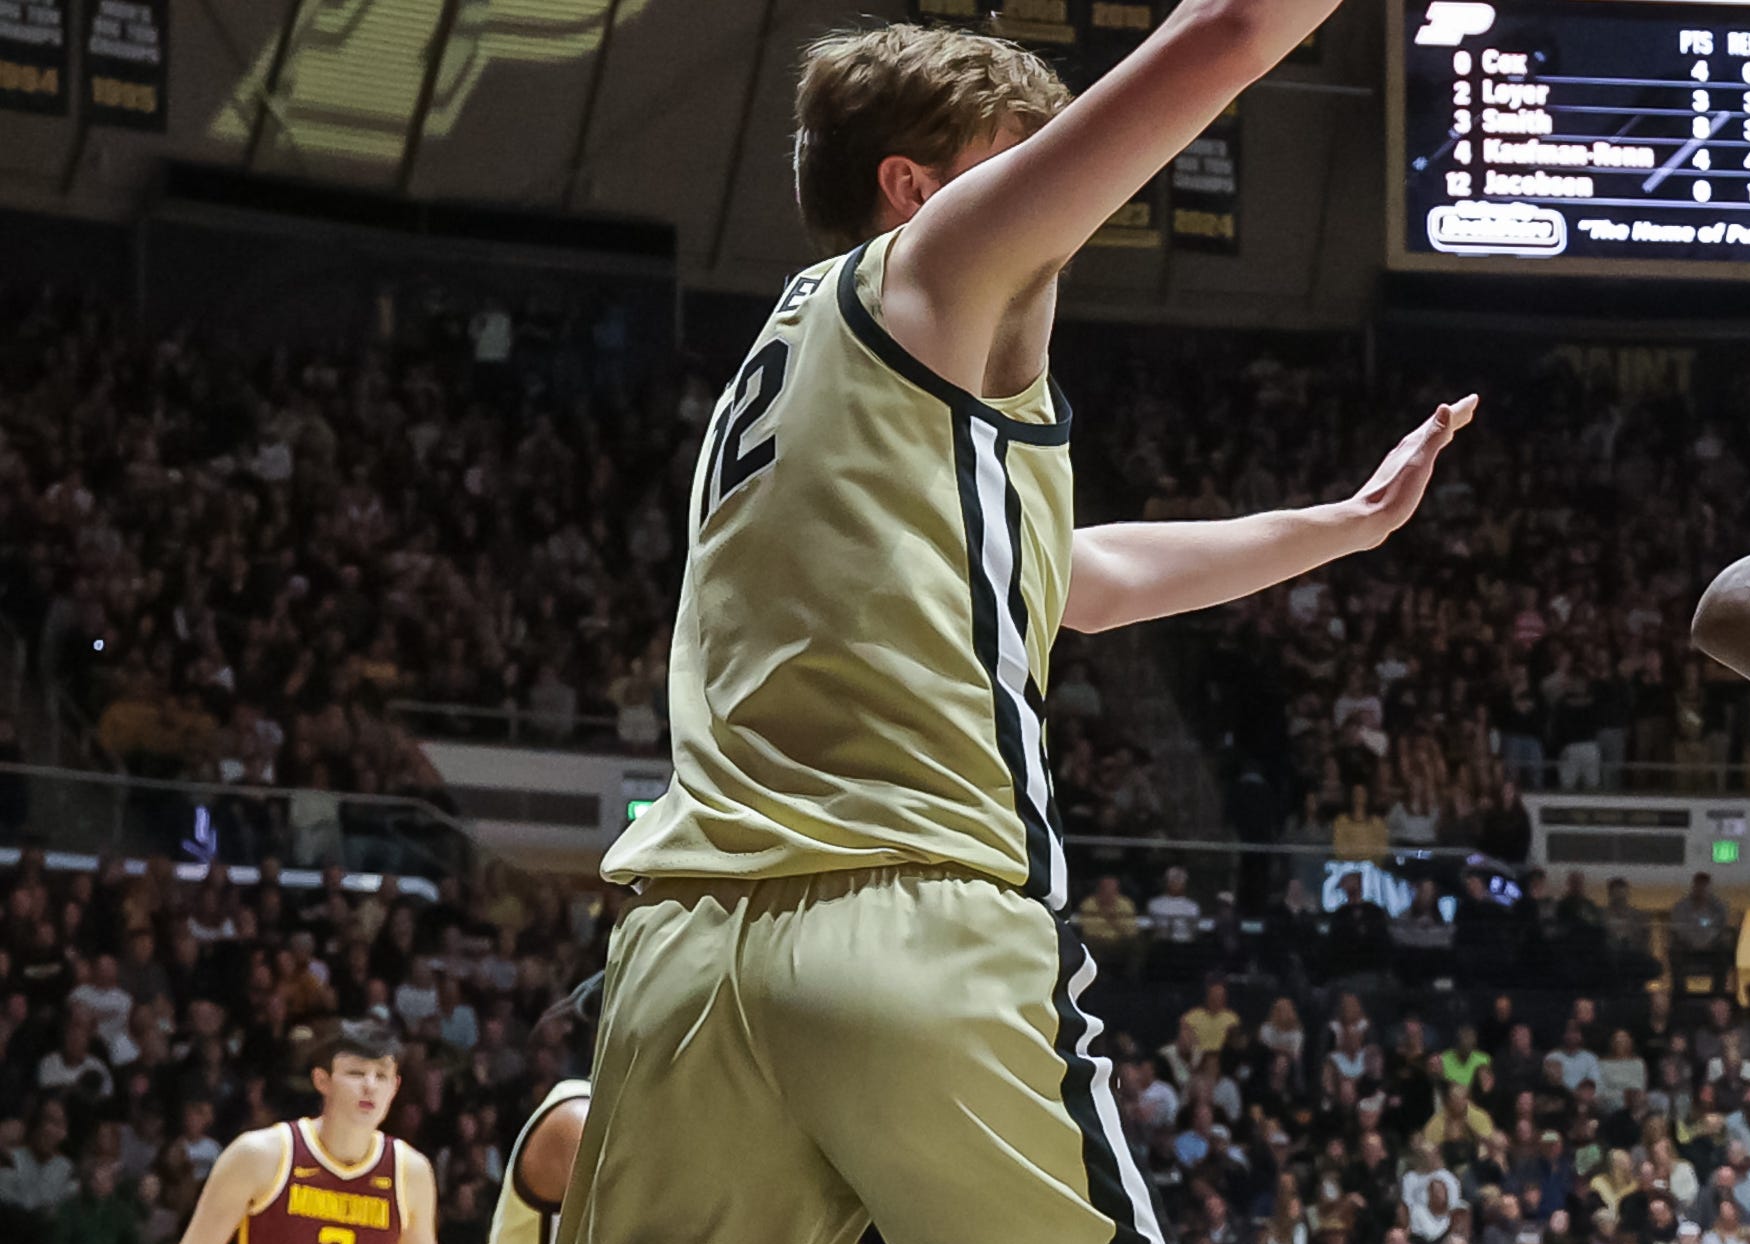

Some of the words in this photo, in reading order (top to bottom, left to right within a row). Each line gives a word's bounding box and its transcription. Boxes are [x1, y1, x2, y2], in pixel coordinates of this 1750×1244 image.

[1679, 30, 1714, 55] PTS
[1453, 51, 1472, 75] 0
[1690, 60, 1709, 82] 4
[1453, 81, 1471, 105] 2
[1482, 80, 1553, 108] Loyer
[1692, 89, 1710, 112] 3
[1453, 109, 1472, 134] 3
[1482, 109, 1553, 134] Smith
[1453, 141, 1472, 165] 4
[1692, 149, 1711, 171] 4
[1445, 171, 1472, 197] 12
[1692, 180, 1711, 203] 0
[1697, 222, 1727, 244] of
